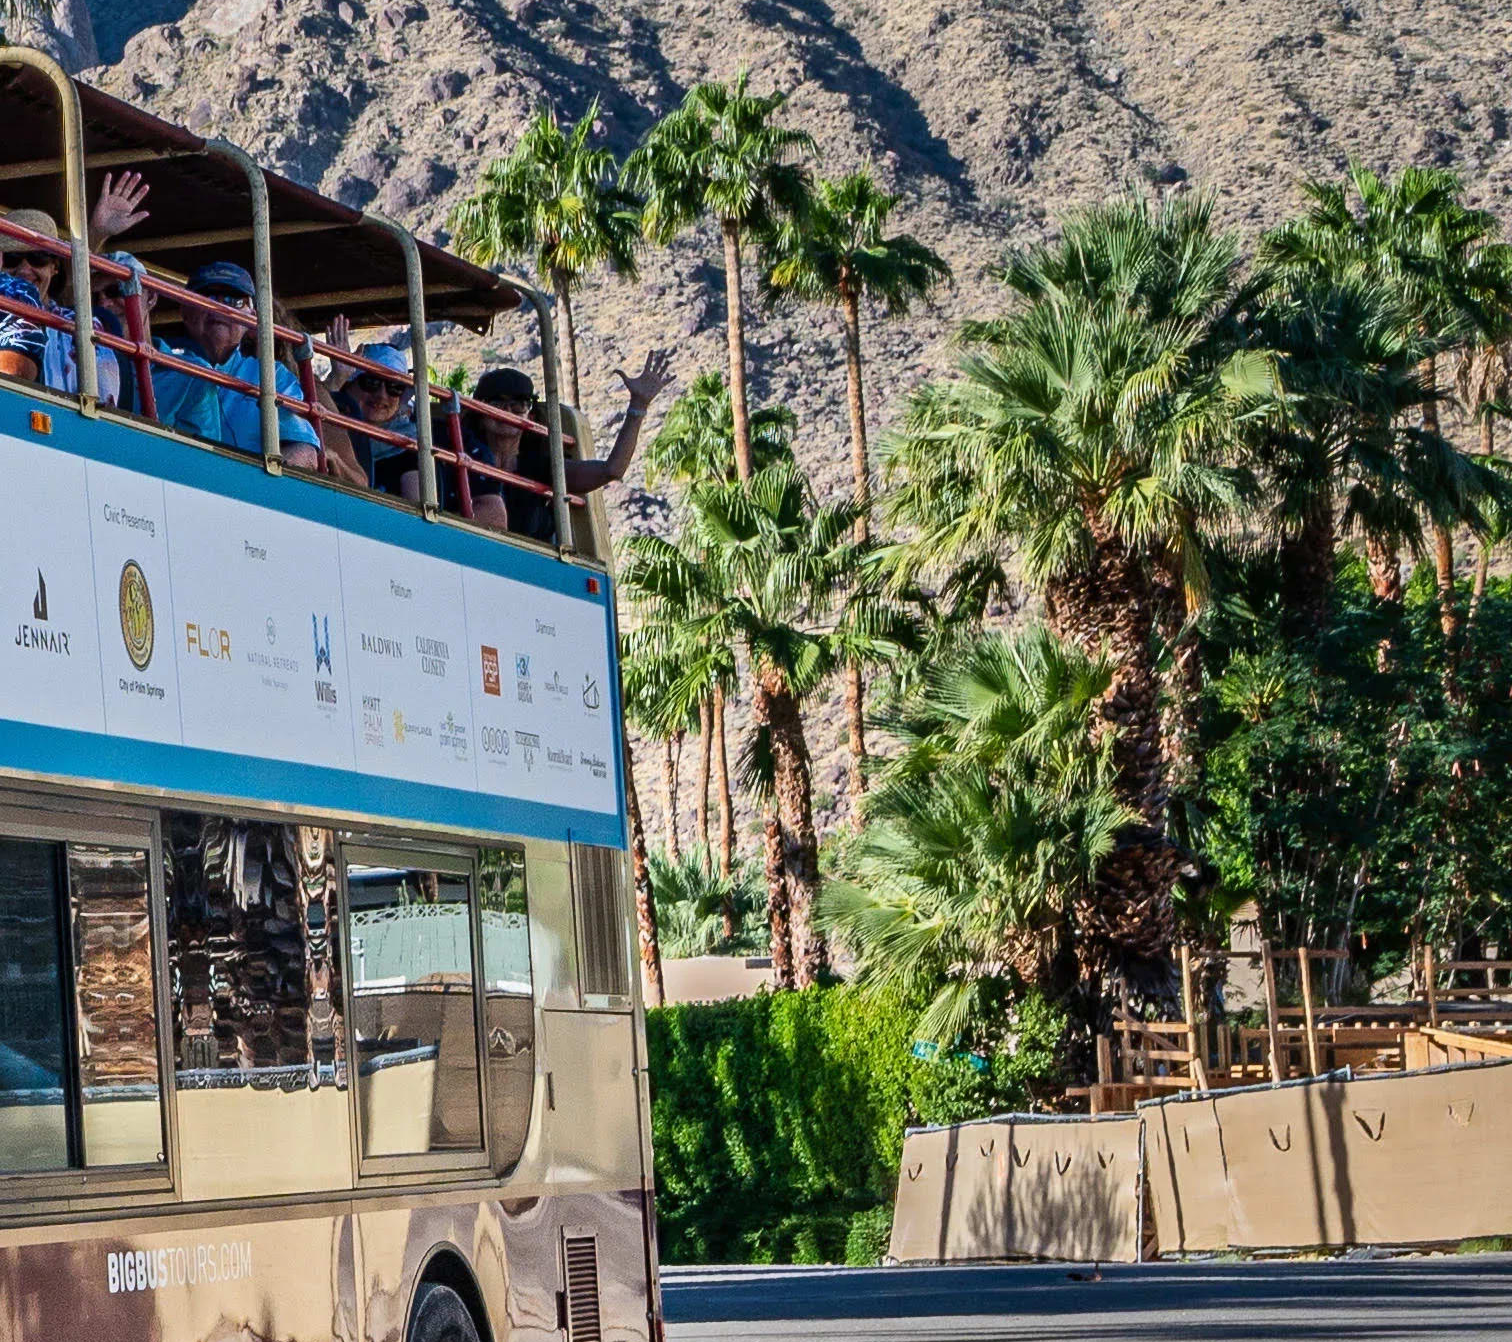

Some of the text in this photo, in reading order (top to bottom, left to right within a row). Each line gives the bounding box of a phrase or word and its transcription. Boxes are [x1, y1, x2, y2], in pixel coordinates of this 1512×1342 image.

[104, 504, 120, 524] Civic
[15, 624, 70, 657] JENNAIR
[186, 622, 232, 661] FLOR
[361, 633, 402, 659] BALDWIN
[107, 1241, 252, 1294] BIGBUSTOURS.COM
